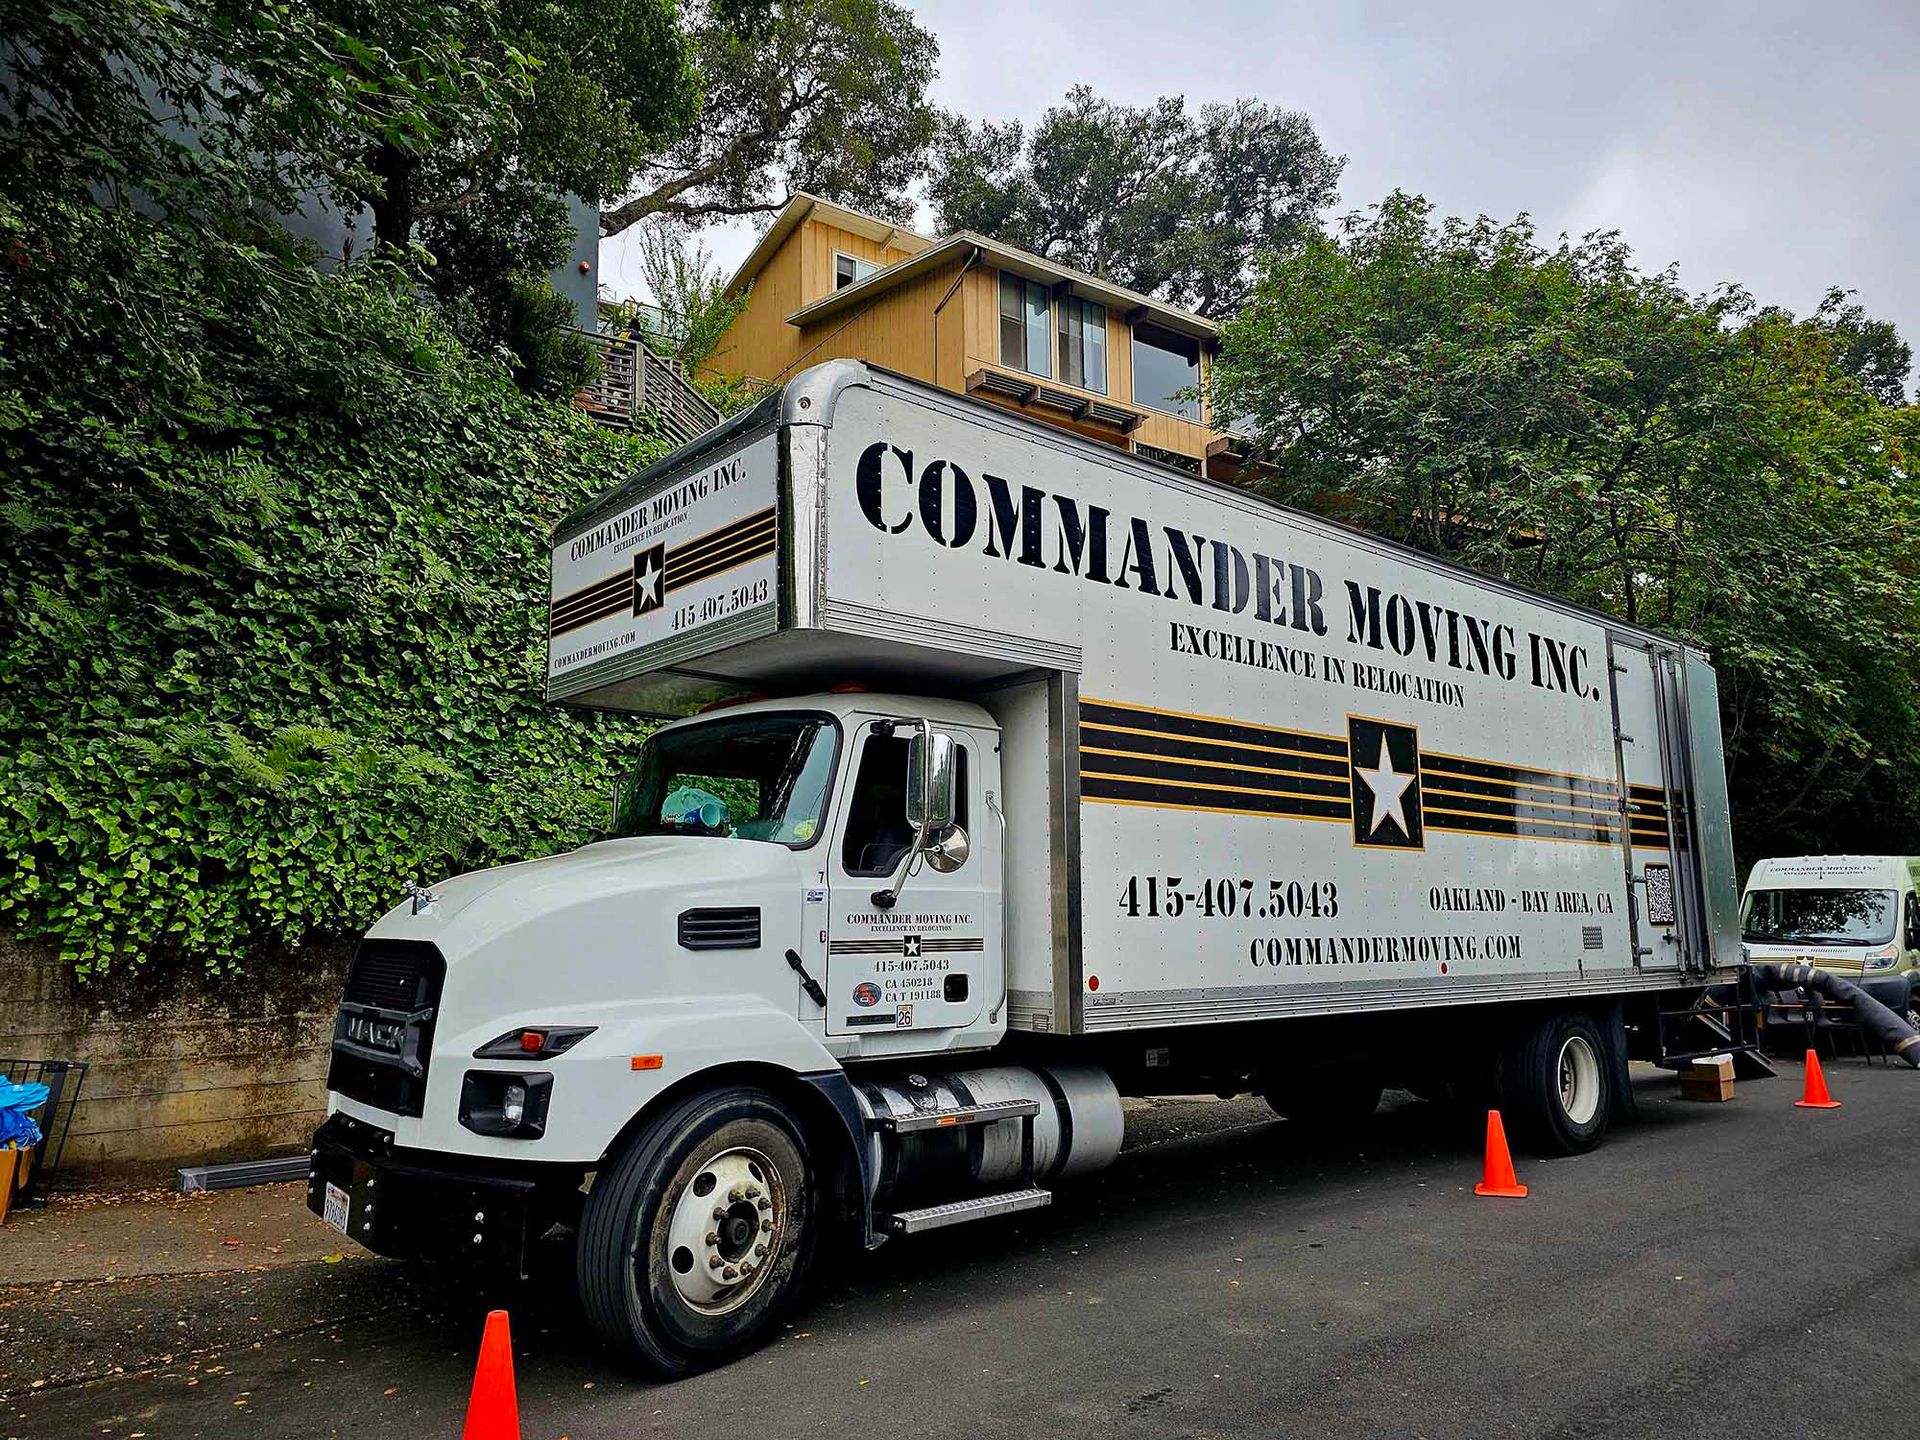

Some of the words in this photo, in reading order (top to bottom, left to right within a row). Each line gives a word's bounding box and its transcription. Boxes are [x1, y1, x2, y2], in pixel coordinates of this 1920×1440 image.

[571, 506, 648, 562] COMMANDER
[652, 475, 709, 523] MOVING
[713, 457, 747, 492] INC.
[613, 532, 646, 554] EXCELLENCE
[653, 511, 689, 535] RELOCATION
[855, 441, 1329, 637] COMMANDER
[1343, 579, 1517, 682] MOVING
[1527, 632, 1601, 702] INC.
[671, 604, 696, 631] 415
[699, 579, 768, 621] 407.5043
[554, 631, 636, 669] COMMANDERMOVING.COM
[1170, 621, 1316, 680] EXCELLENCE
[1323, 655, 1345, 684] IN
[1353, 662, 1465, 709] RELOCATION
[1118, 875, 1339, 918] 415-407.5043
[1429, 887, 1506, 912] OAKLAND
[1521, 890, 1550, 913] BAY
[1554, 891, 1594, 916] AREA,
[1597, 892, 1614, 914] CA
[847, 913, 912, 925] COMMANDER
[915, 913, 952, 924] MOVING
[954, 913, 973, 924] INC.
[874, 959, 950, 972] 415-407.5043
[1249, 935, 1522, 967] COMMANDERMOVING.COM
[885, 979, 898, 989] CA
[901, 977, 933, 988] 450218
[885, 992, 898, 1002] CA
[900, 992, 907, 1002] T
[910, 990, 941, 1001] 191188
[898, 1011, 911, 1026] 26
